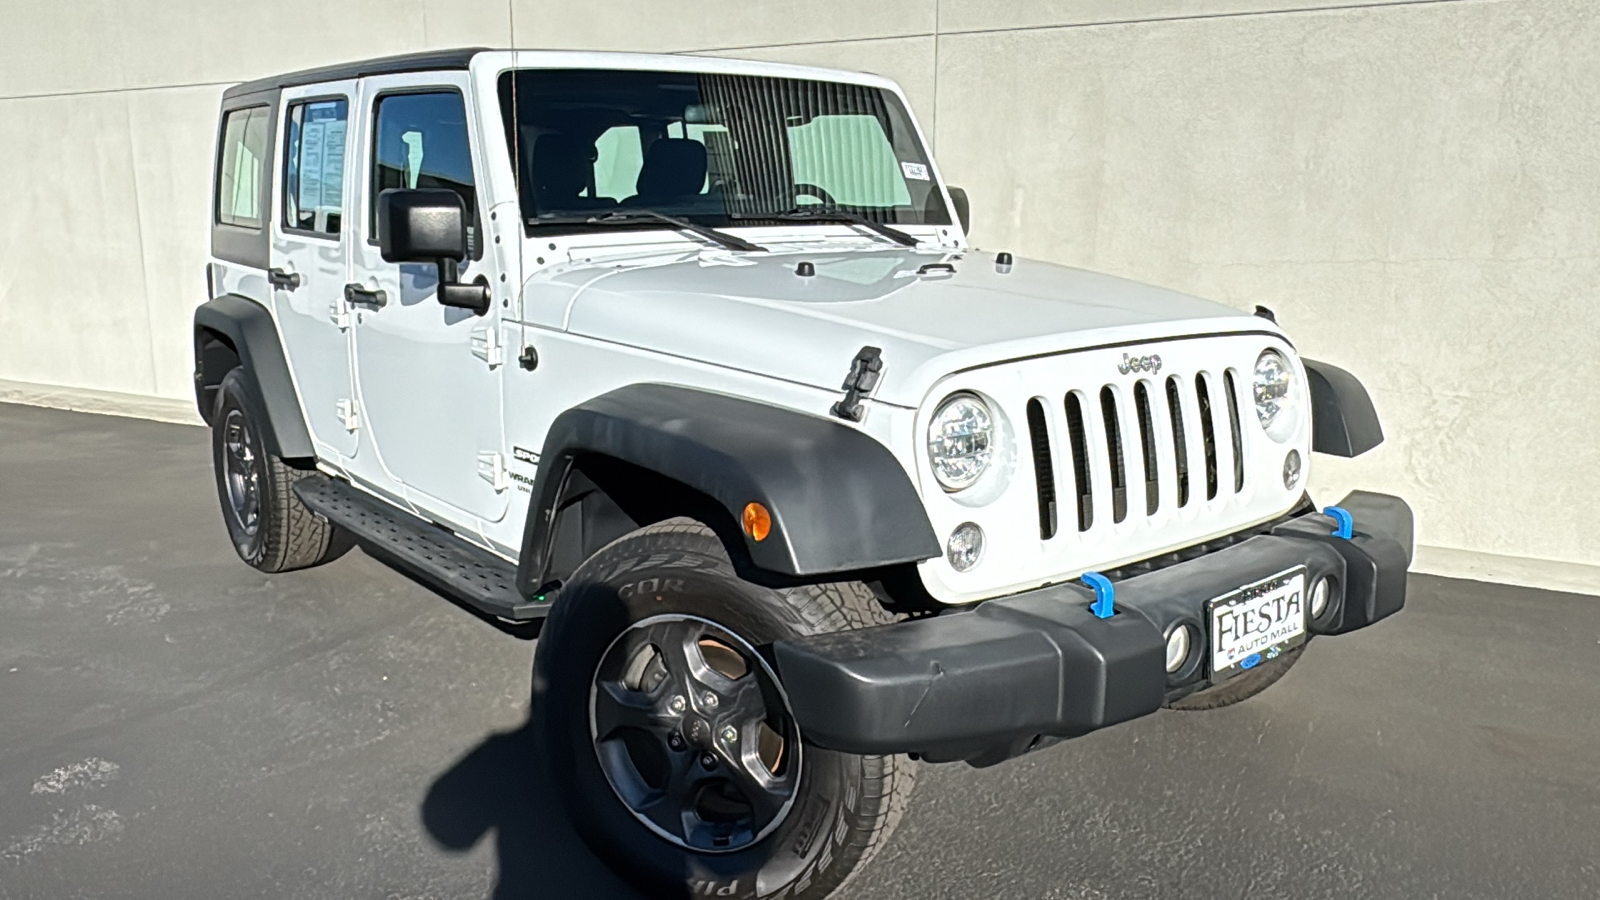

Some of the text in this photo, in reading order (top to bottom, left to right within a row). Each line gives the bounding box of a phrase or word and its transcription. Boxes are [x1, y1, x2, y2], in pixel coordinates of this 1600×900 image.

[1117, 352, 1162, 375] Jeep
[1216, 590, 1301, 654] FIESTA
[1238, 622, 1298, 655] AUTO MALL
